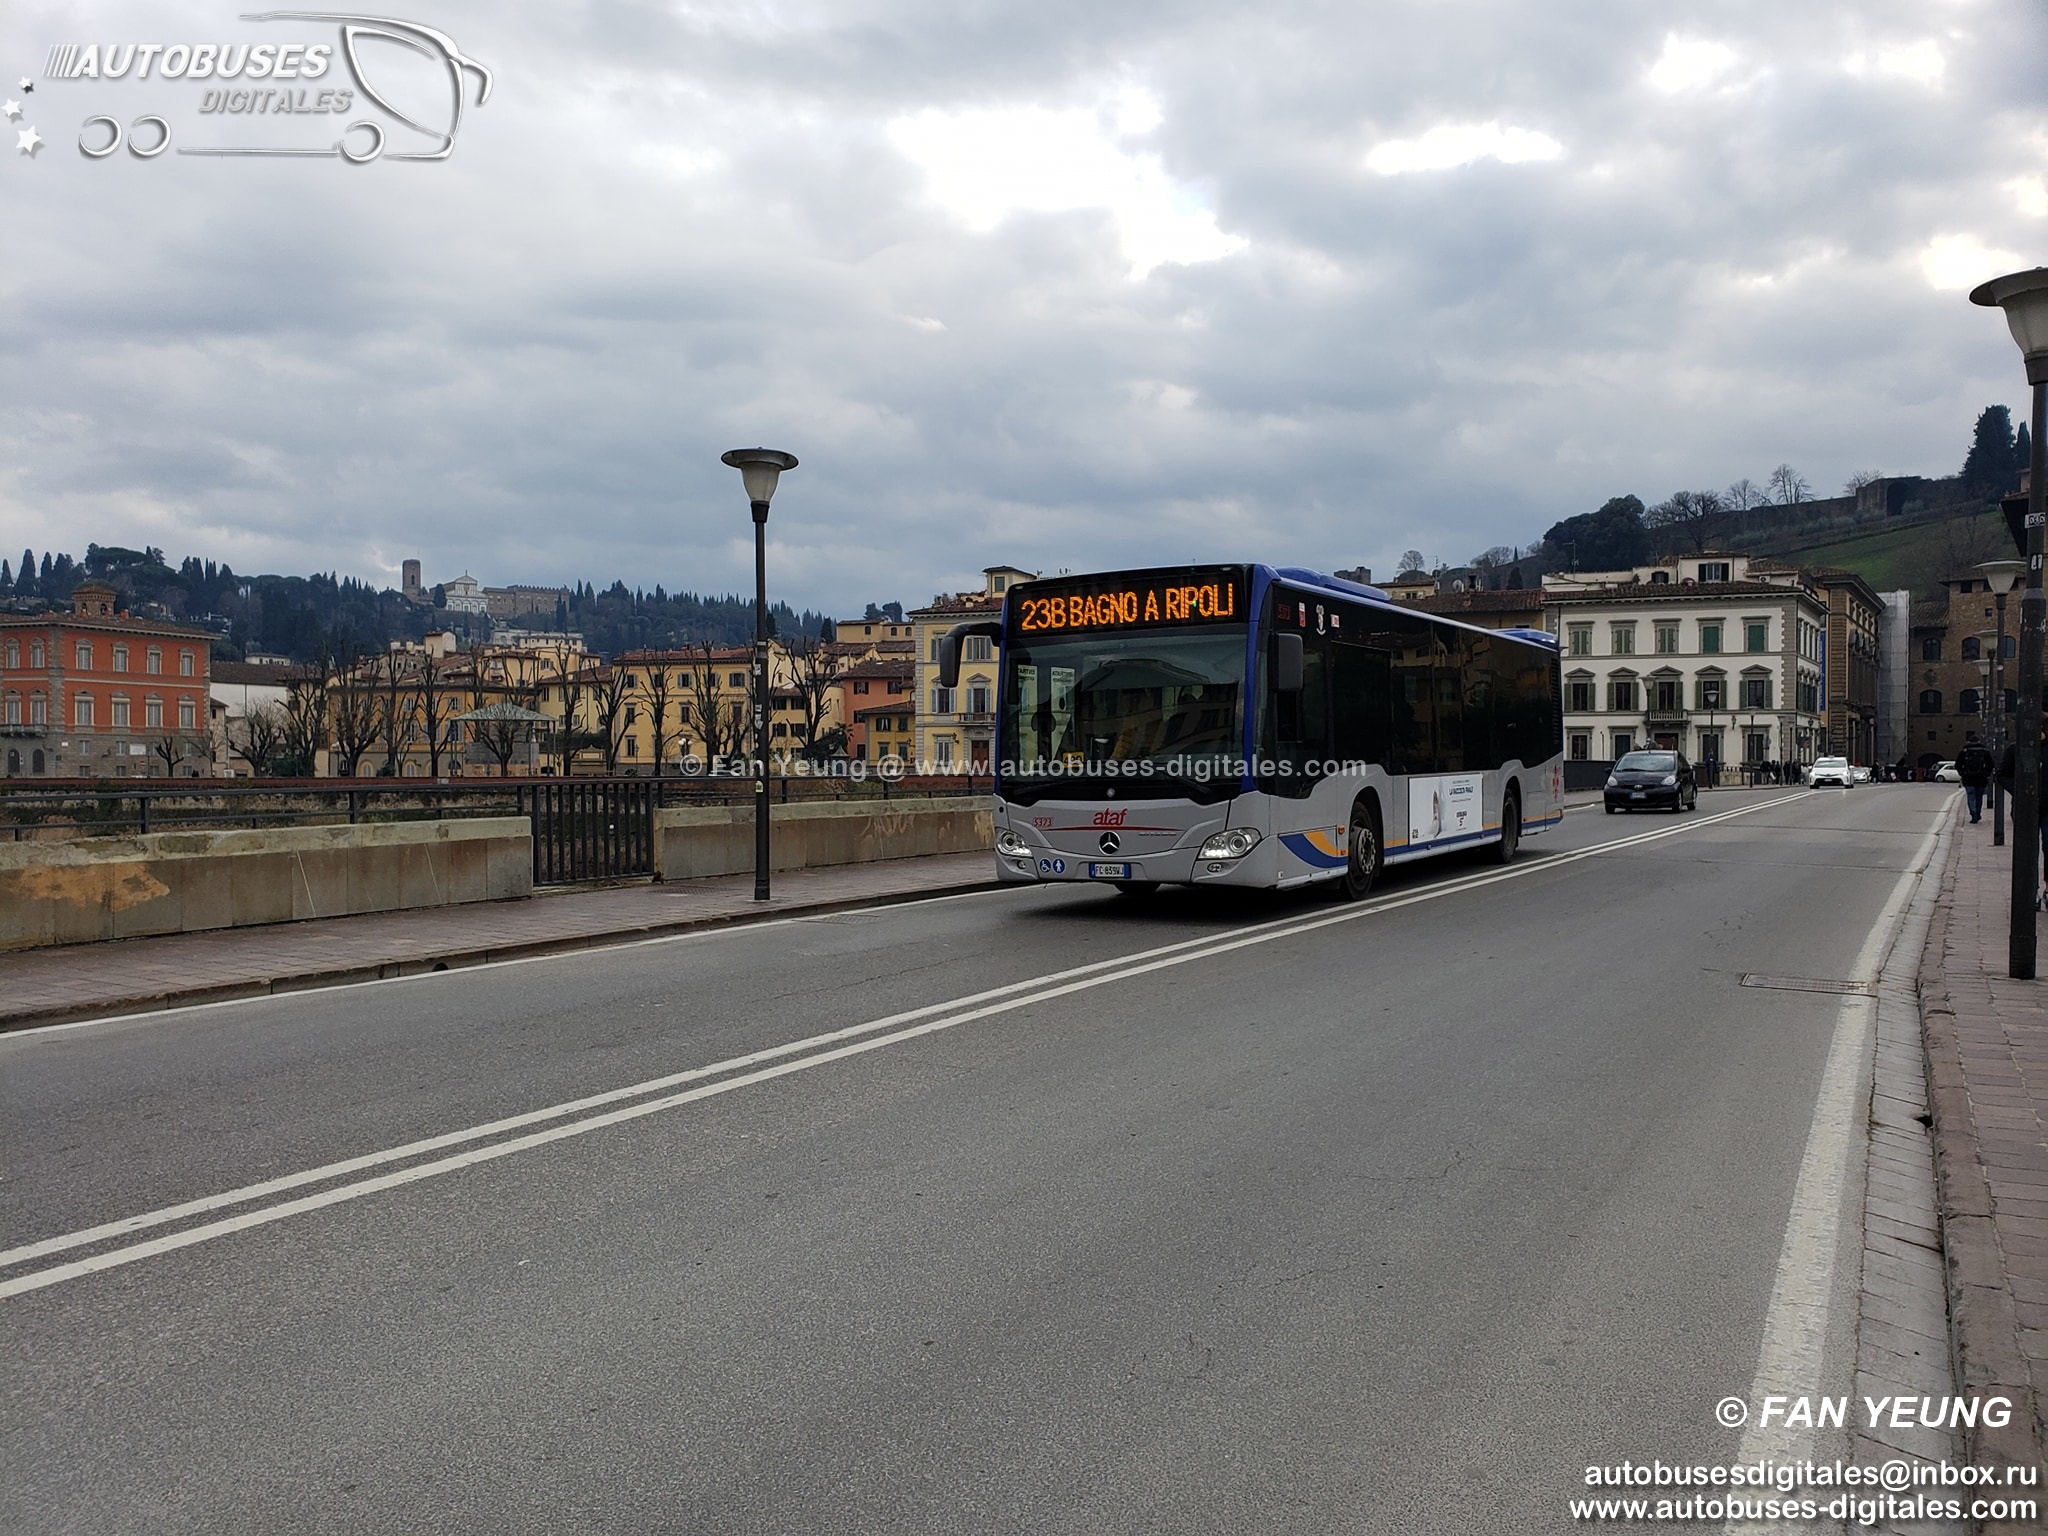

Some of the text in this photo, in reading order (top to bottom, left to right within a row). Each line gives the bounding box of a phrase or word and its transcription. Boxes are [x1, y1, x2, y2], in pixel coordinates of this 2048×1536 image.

[1021, 582, 1234, 631] 23B BAGNO A RIPOLI
[1093, 808, 1128, 826] ataf
